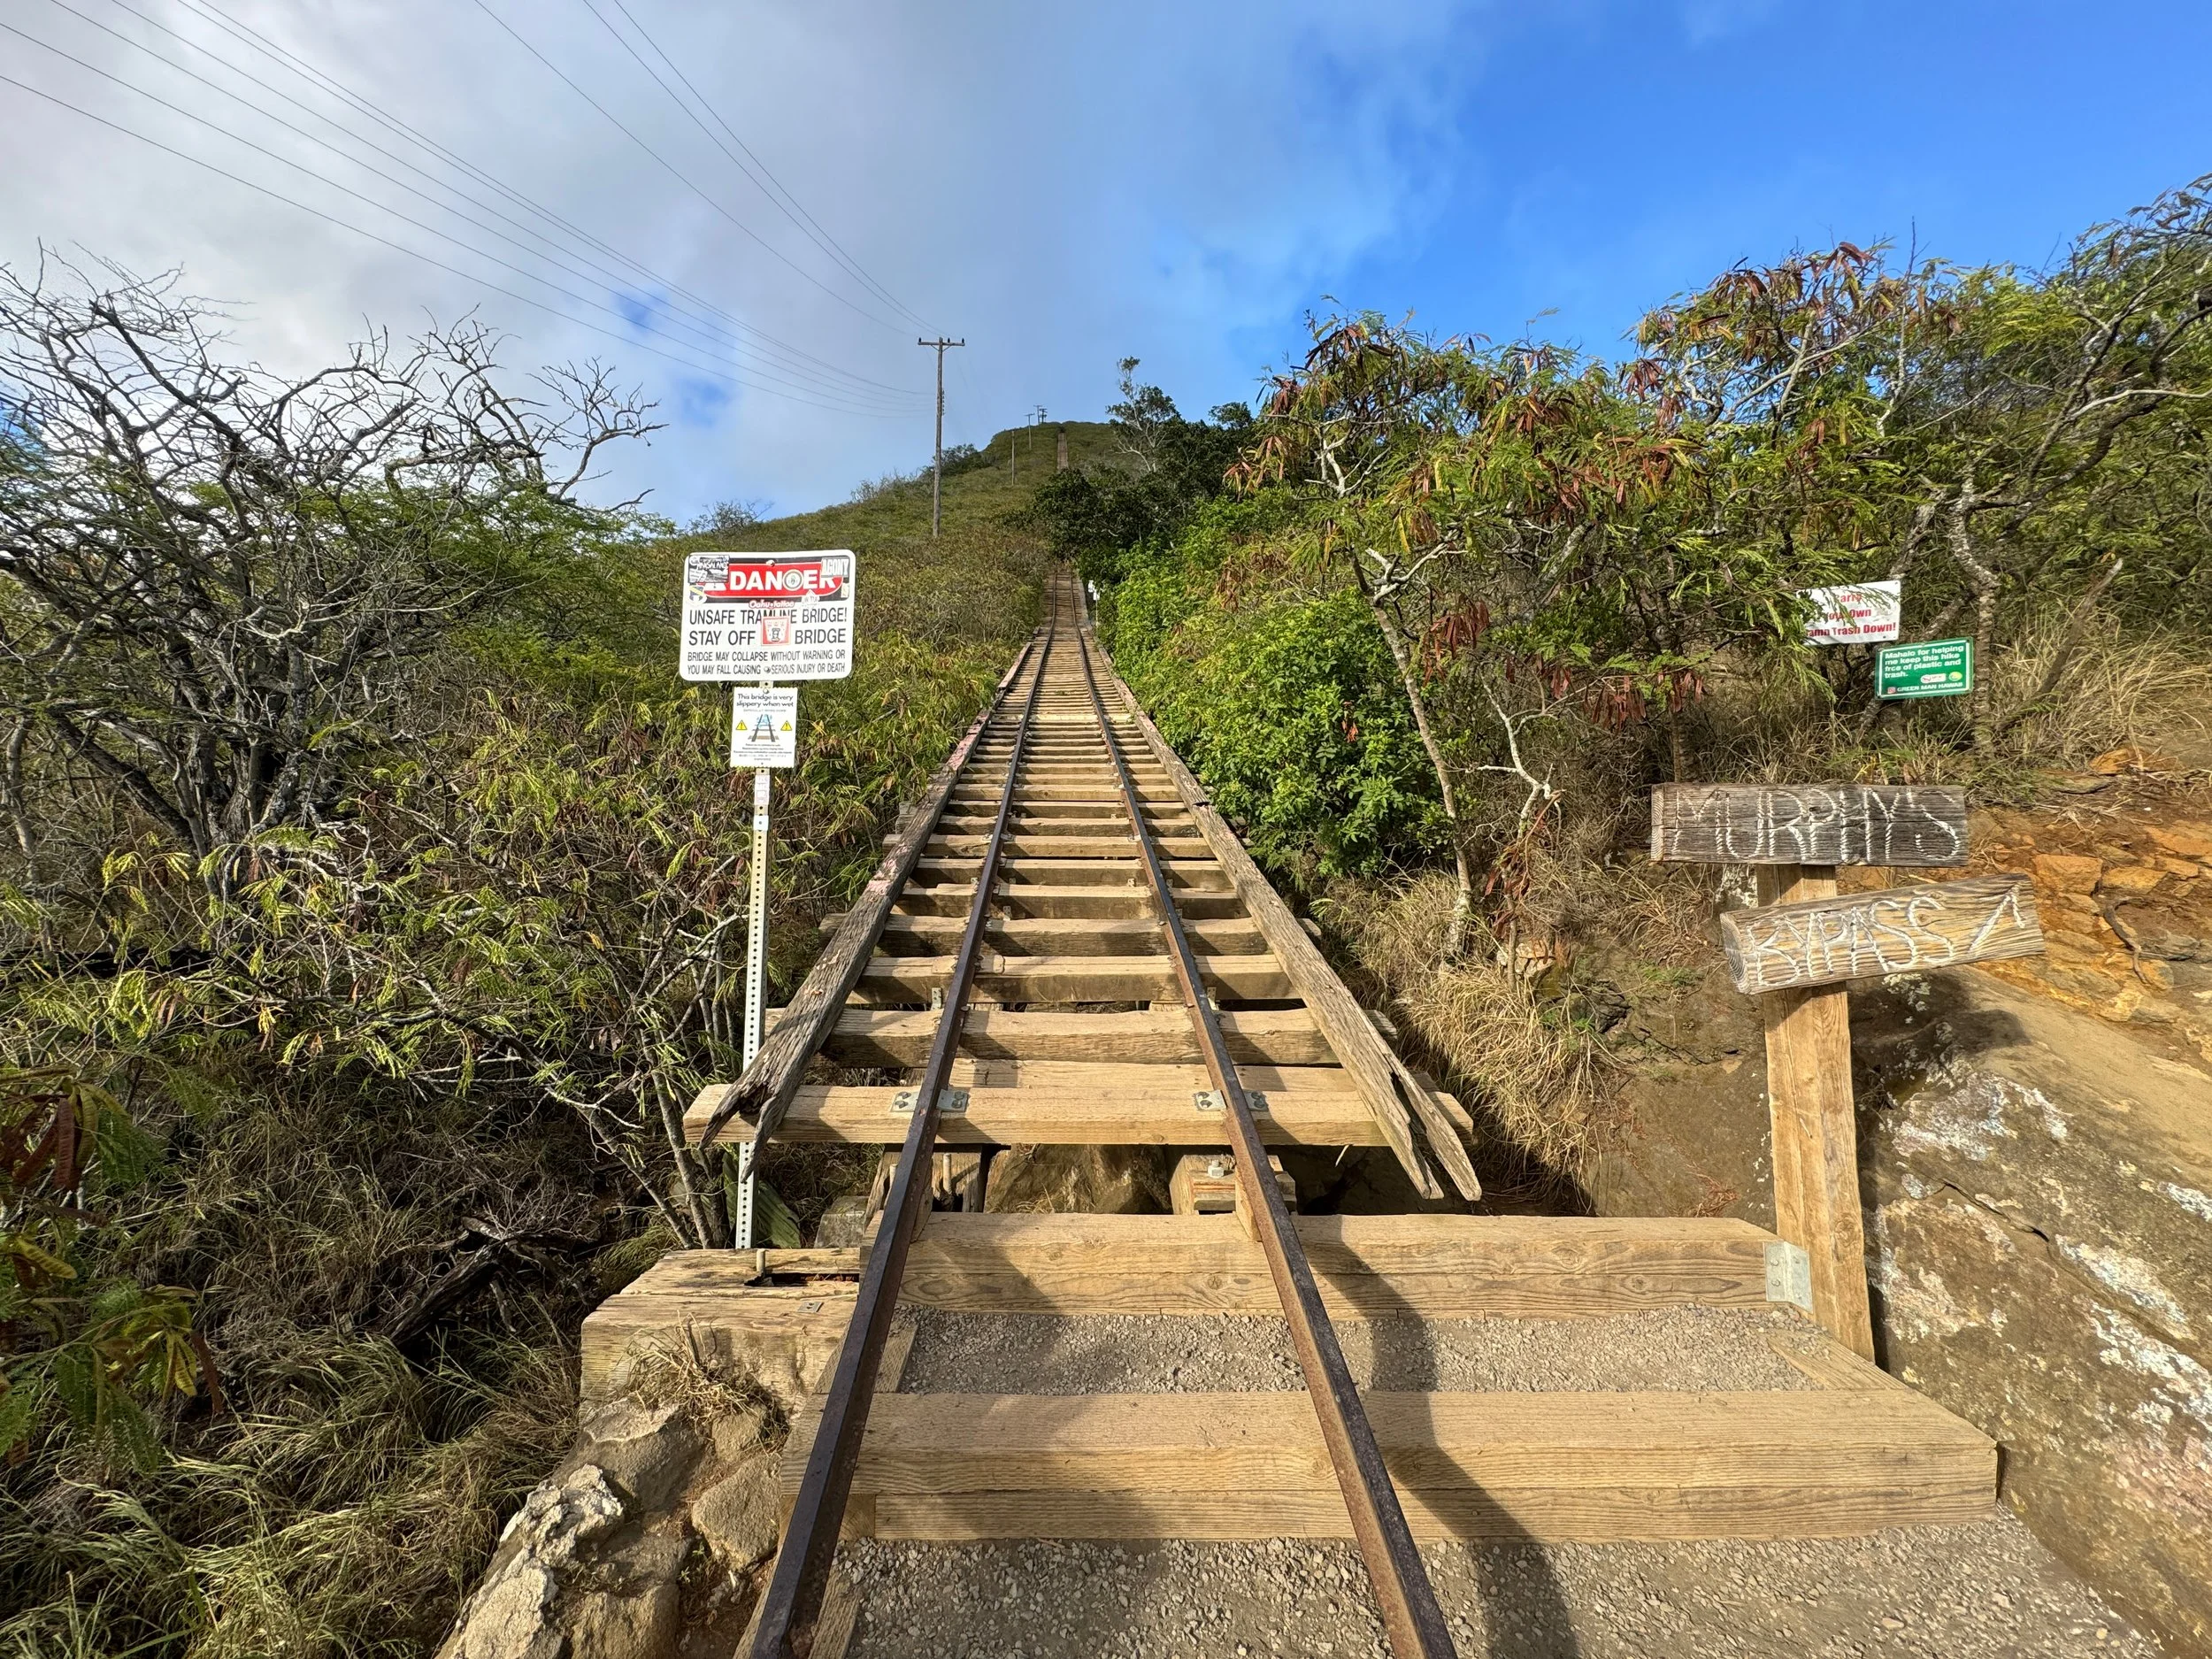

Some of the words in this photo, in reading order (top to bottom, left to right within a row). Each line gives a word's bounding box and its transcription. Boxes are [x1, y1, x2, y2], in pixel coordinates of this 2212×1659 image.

[729, 569, 837, 591] DANER
[689, 610, 735, 625] UNSAFE
[802, 607, 848, 623] BRIDGE!
[1849, 609, 1872, 618] Own
[1806, 628, 1830, 637] amn
[1832, 626, 1861, 636] Trash
[1863, 622, 1896, 634] Down!
[688, 630, 722, 646] STAY
[727, 630, 756, 646] OFF
[795, 628, 847, 644] BRIDGE
[687, 651, 713, 662] BRIDGE
[715, 651, 730, 661] MAY
[732, 651, 768, 661] COLLAPSE
[771, 650, 801, 661] WITHOUT
[803, 649, 833, 660] WARNING
[835, 649, 846, 659] OR
[1885, 650, 1916, 659] Mahalo
[1932, 645, 1964, 654] helping
[687, 664, 700, 674] YOU
[702, 664, 715, 674] MAY
[717, 664, 732, 674] FALL
[733, 664, 761, 674] CAUSING
[771, 664, 795, 674] SERIOUS
[796, 664, 816, 673] INJURY
[817, 663, 826, 672] OR
[827, 662, 845, 672] DEATH
[1913, 661, 1942, 670] plastic
[1745, 893, 1955, 987] BYPASS
